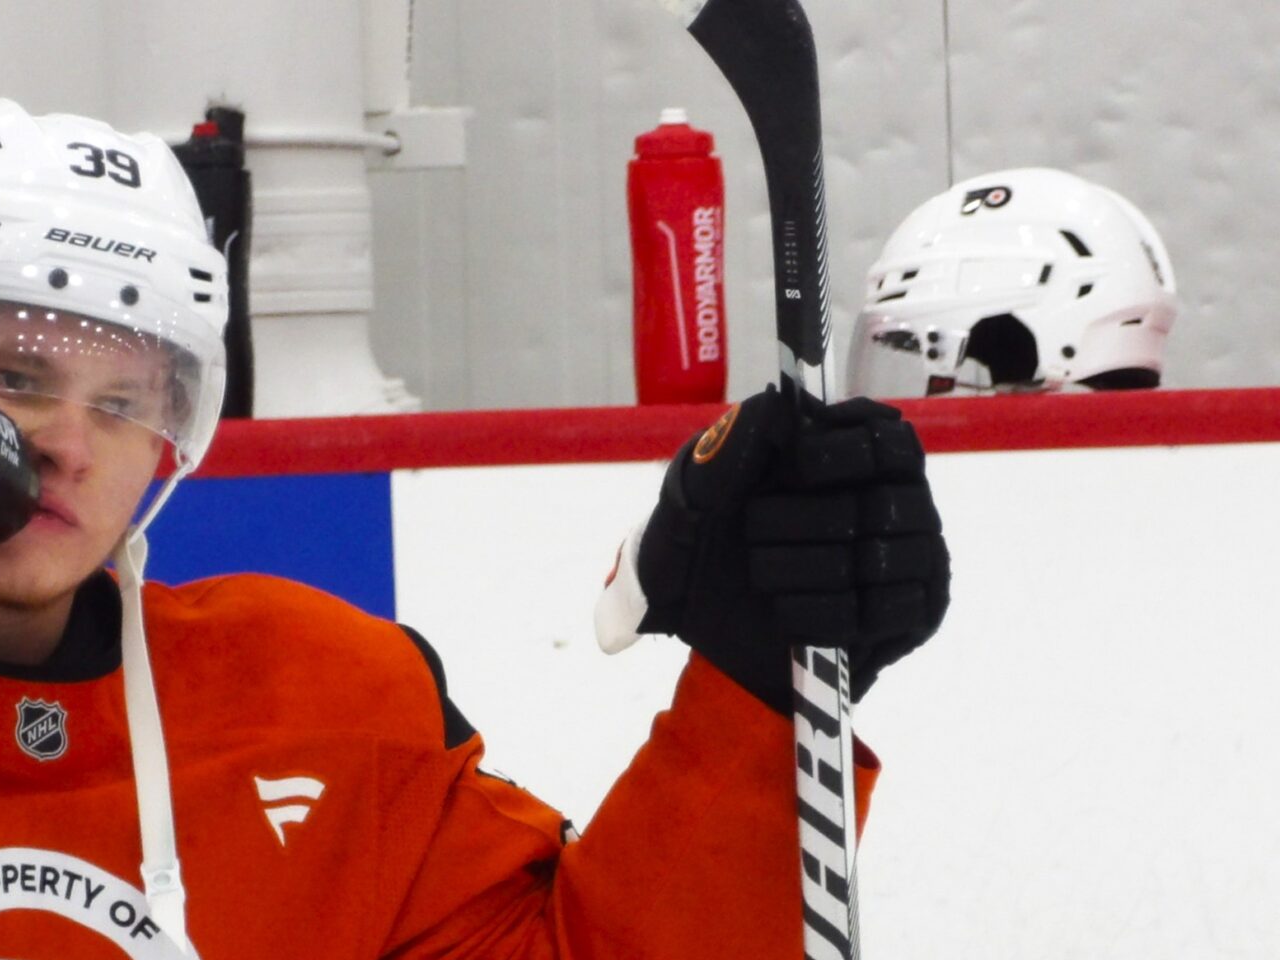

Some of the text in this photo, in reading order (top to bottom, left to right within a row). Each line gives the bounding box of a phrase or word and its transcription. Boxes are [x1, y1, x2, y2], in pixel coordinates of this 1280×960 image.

[66, 141, 143, 189] 39
[692, 206, 720, 362] BODYARMOR
[26, 716, 58, 744] NHL
[108, 898, 160, 944] OF
